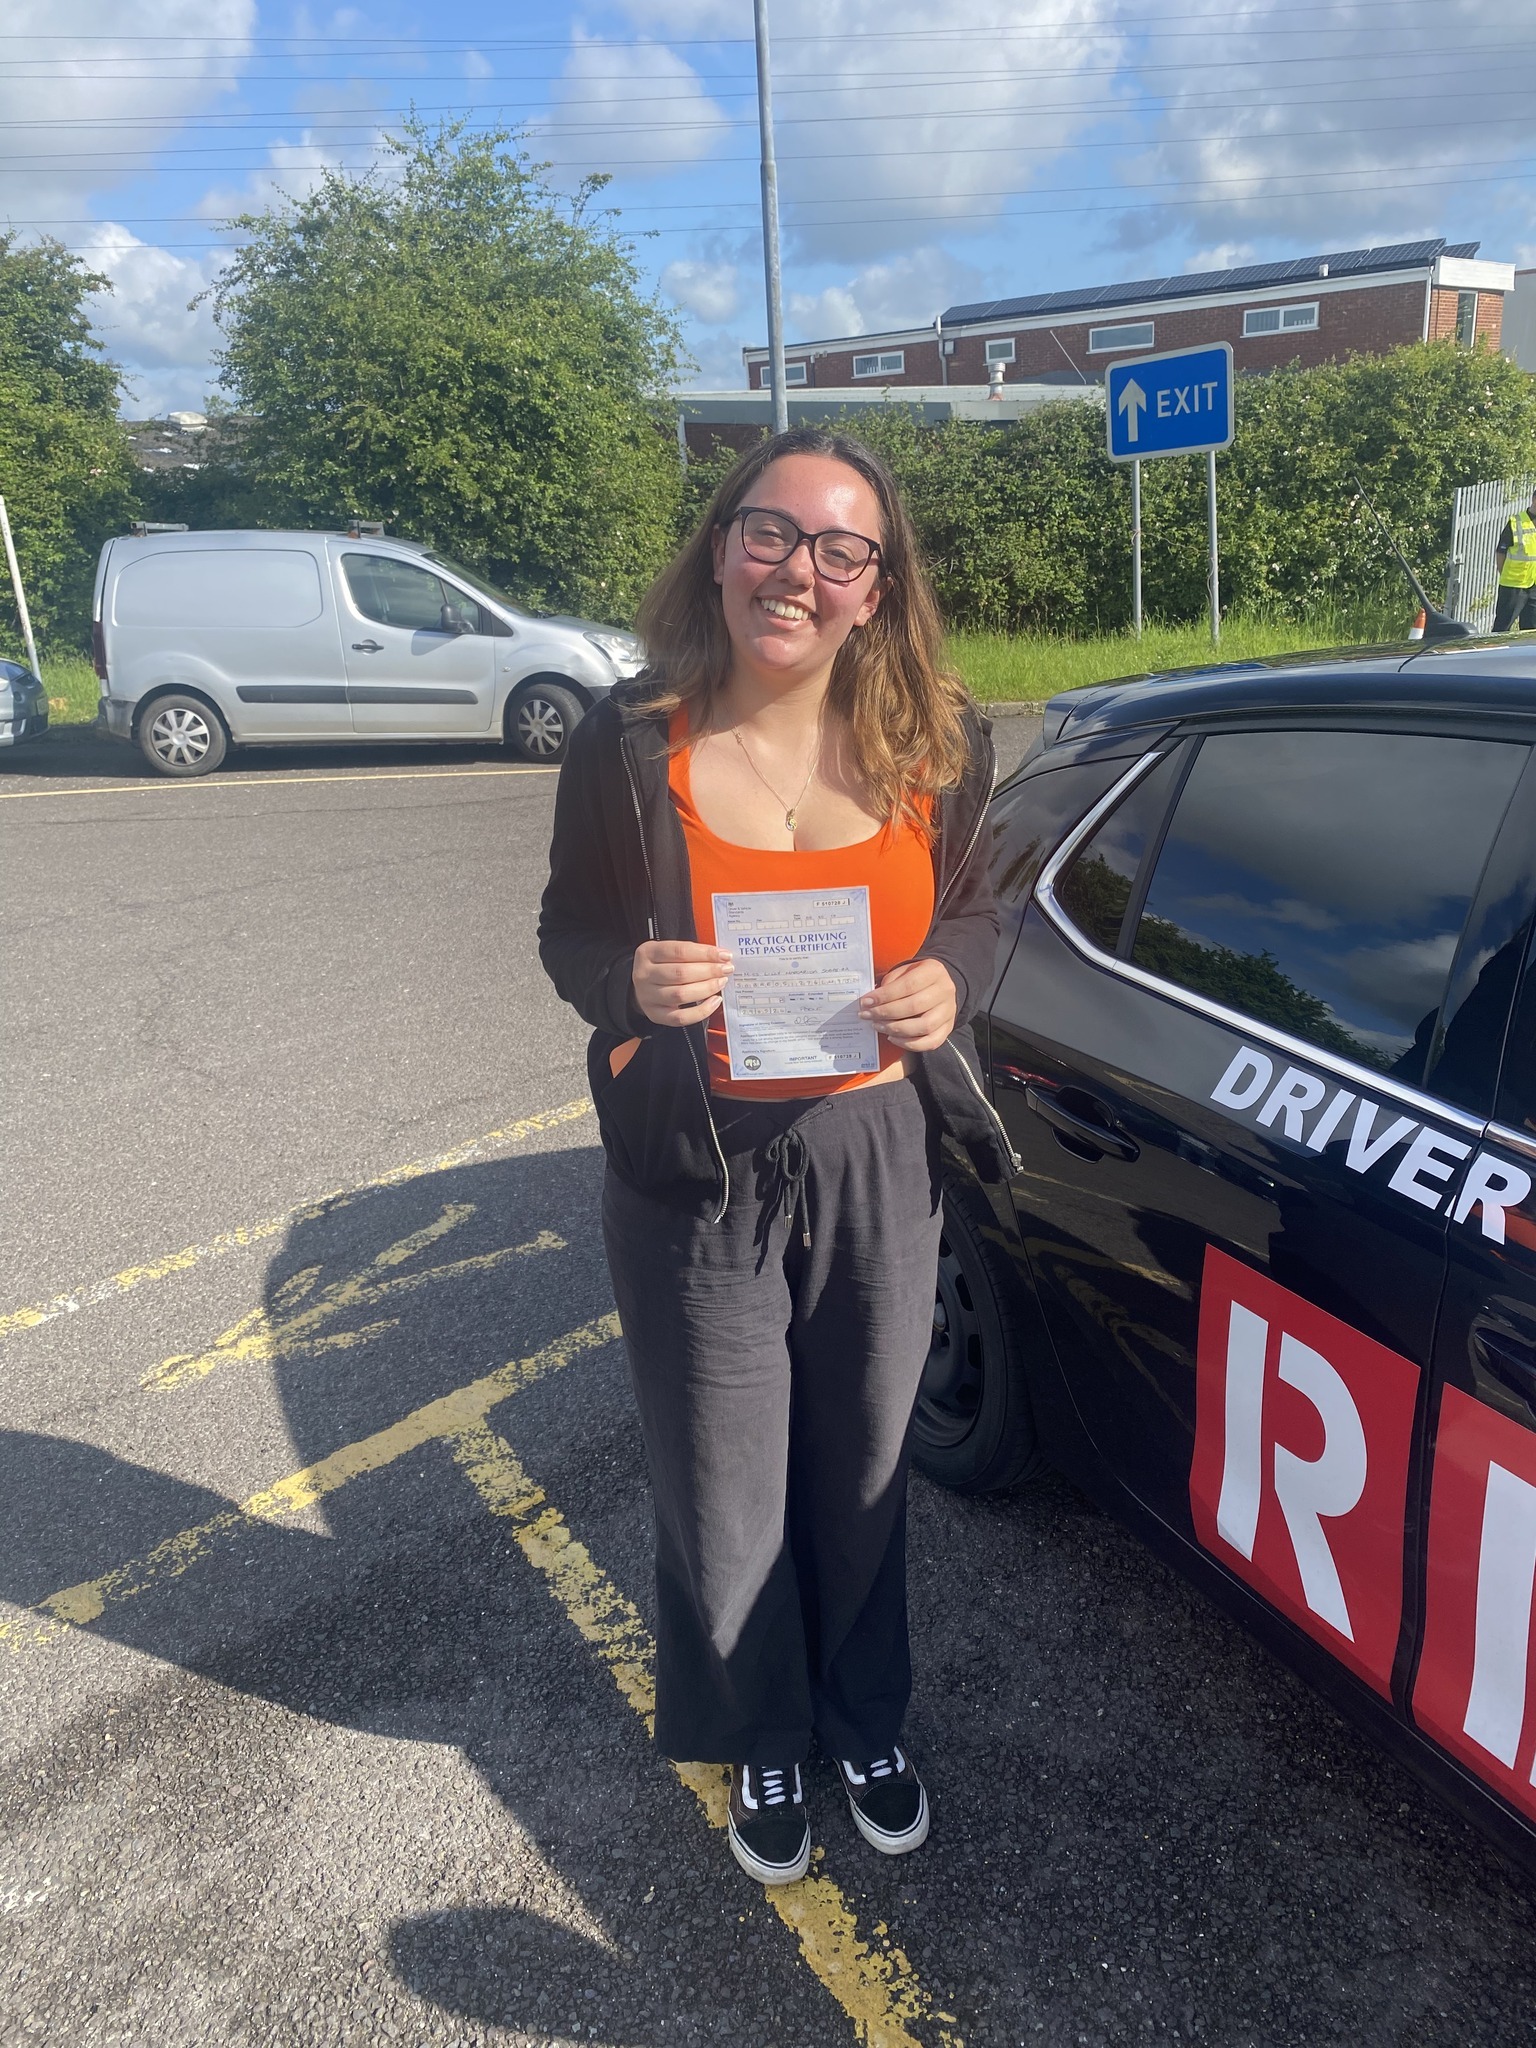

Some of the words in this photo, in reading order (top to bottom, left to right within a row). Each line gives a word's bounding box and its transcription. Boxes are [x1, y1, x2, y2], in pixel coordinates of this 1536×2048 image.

[1157, 382, 1218, 418] EXIT
[738, 935, 796, 946] PRACTICAL
[799, 931, 847, 943] DRIVING
[739, 947, 760, 956] TEST
[763, 945, 786, 954] PASS
[788, 941, 848, 953] CERTIFICATE
[1210, 1045, 1532, 1245] DRIVER
